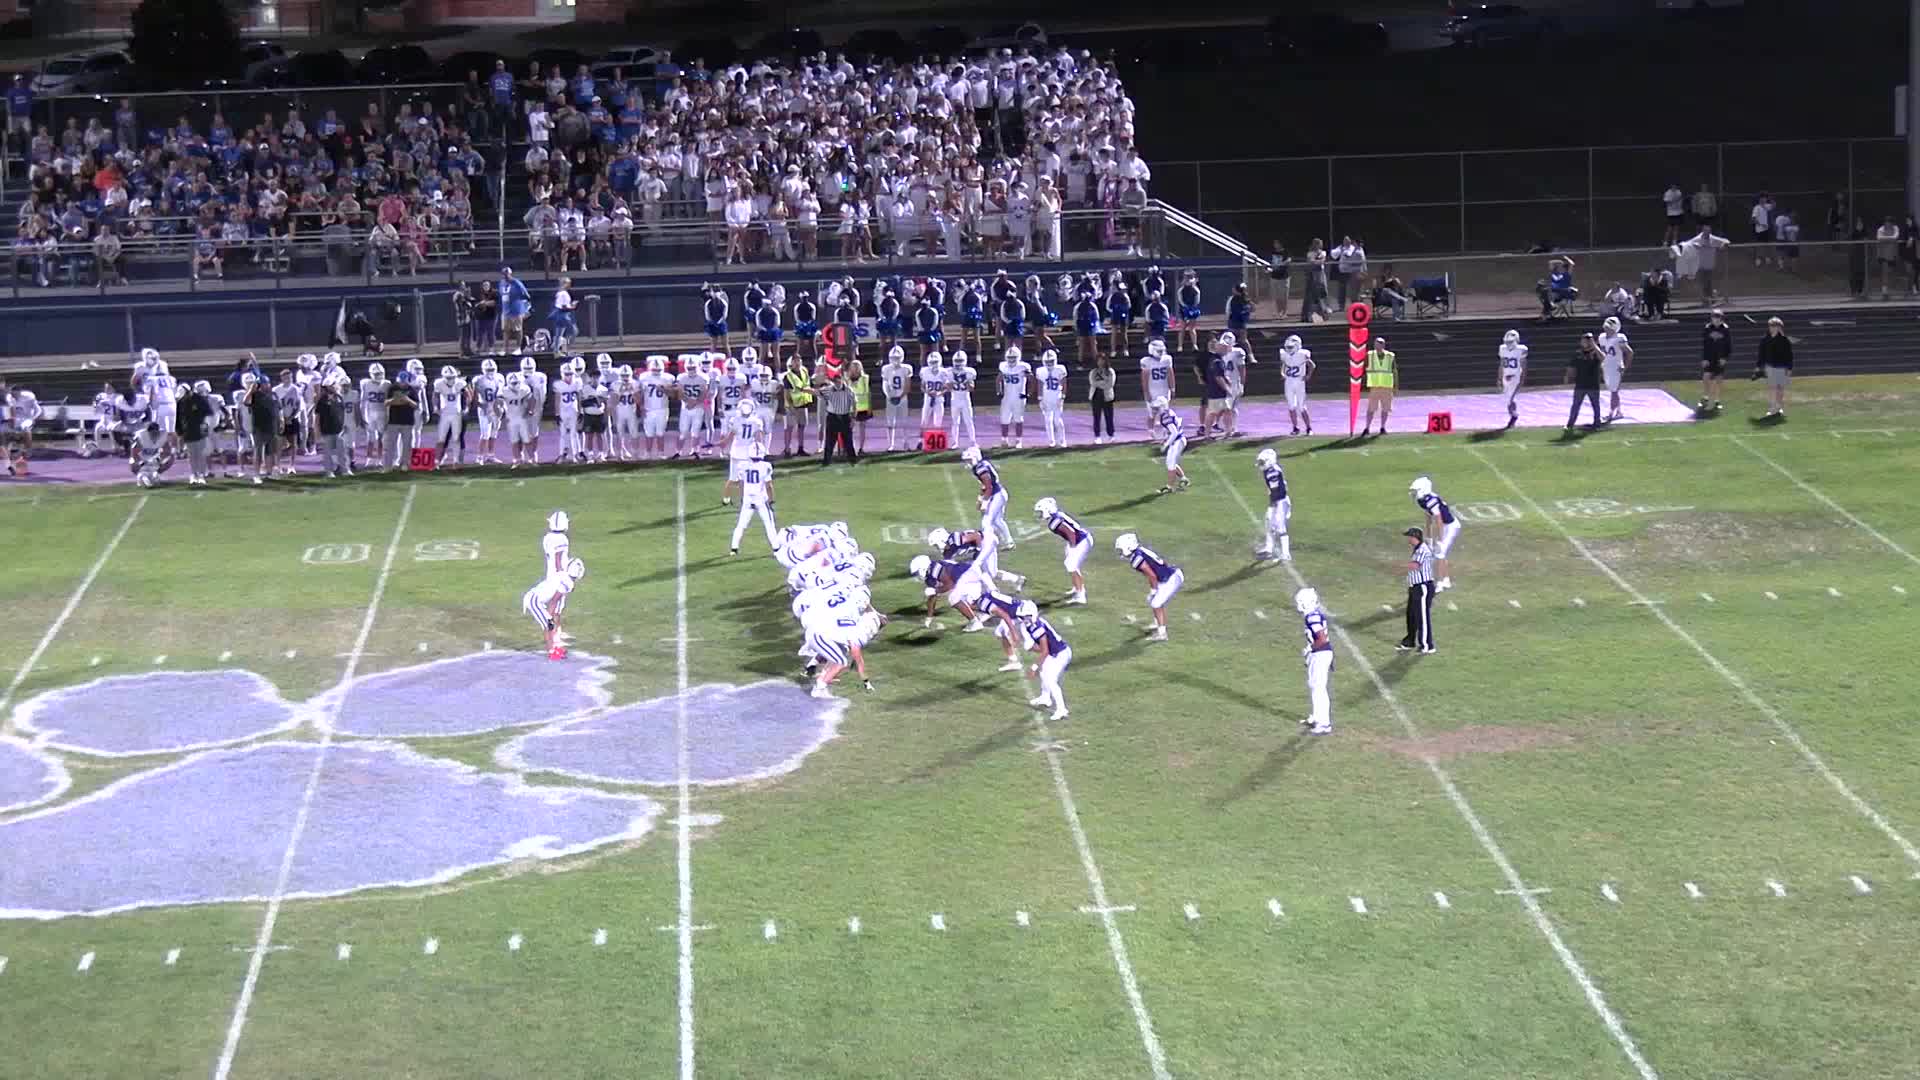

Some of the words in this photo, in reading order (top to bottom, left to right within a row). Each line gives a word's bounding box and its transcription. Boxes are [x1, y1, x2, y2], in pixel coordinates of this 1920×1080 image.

[1151, 368, 1167, 381] 65
[892, 376, 902, 390] 9
[684, 384, 702, 398] 55
[724, 385, 742, 399] 26
[741, 423, 753, 439] 11
[1431, 415, 1452, 432] 30
[926, 434, 946, 450] 40
[411, 448, 432, 467] 50
[745, 469, 760, 484] 10
